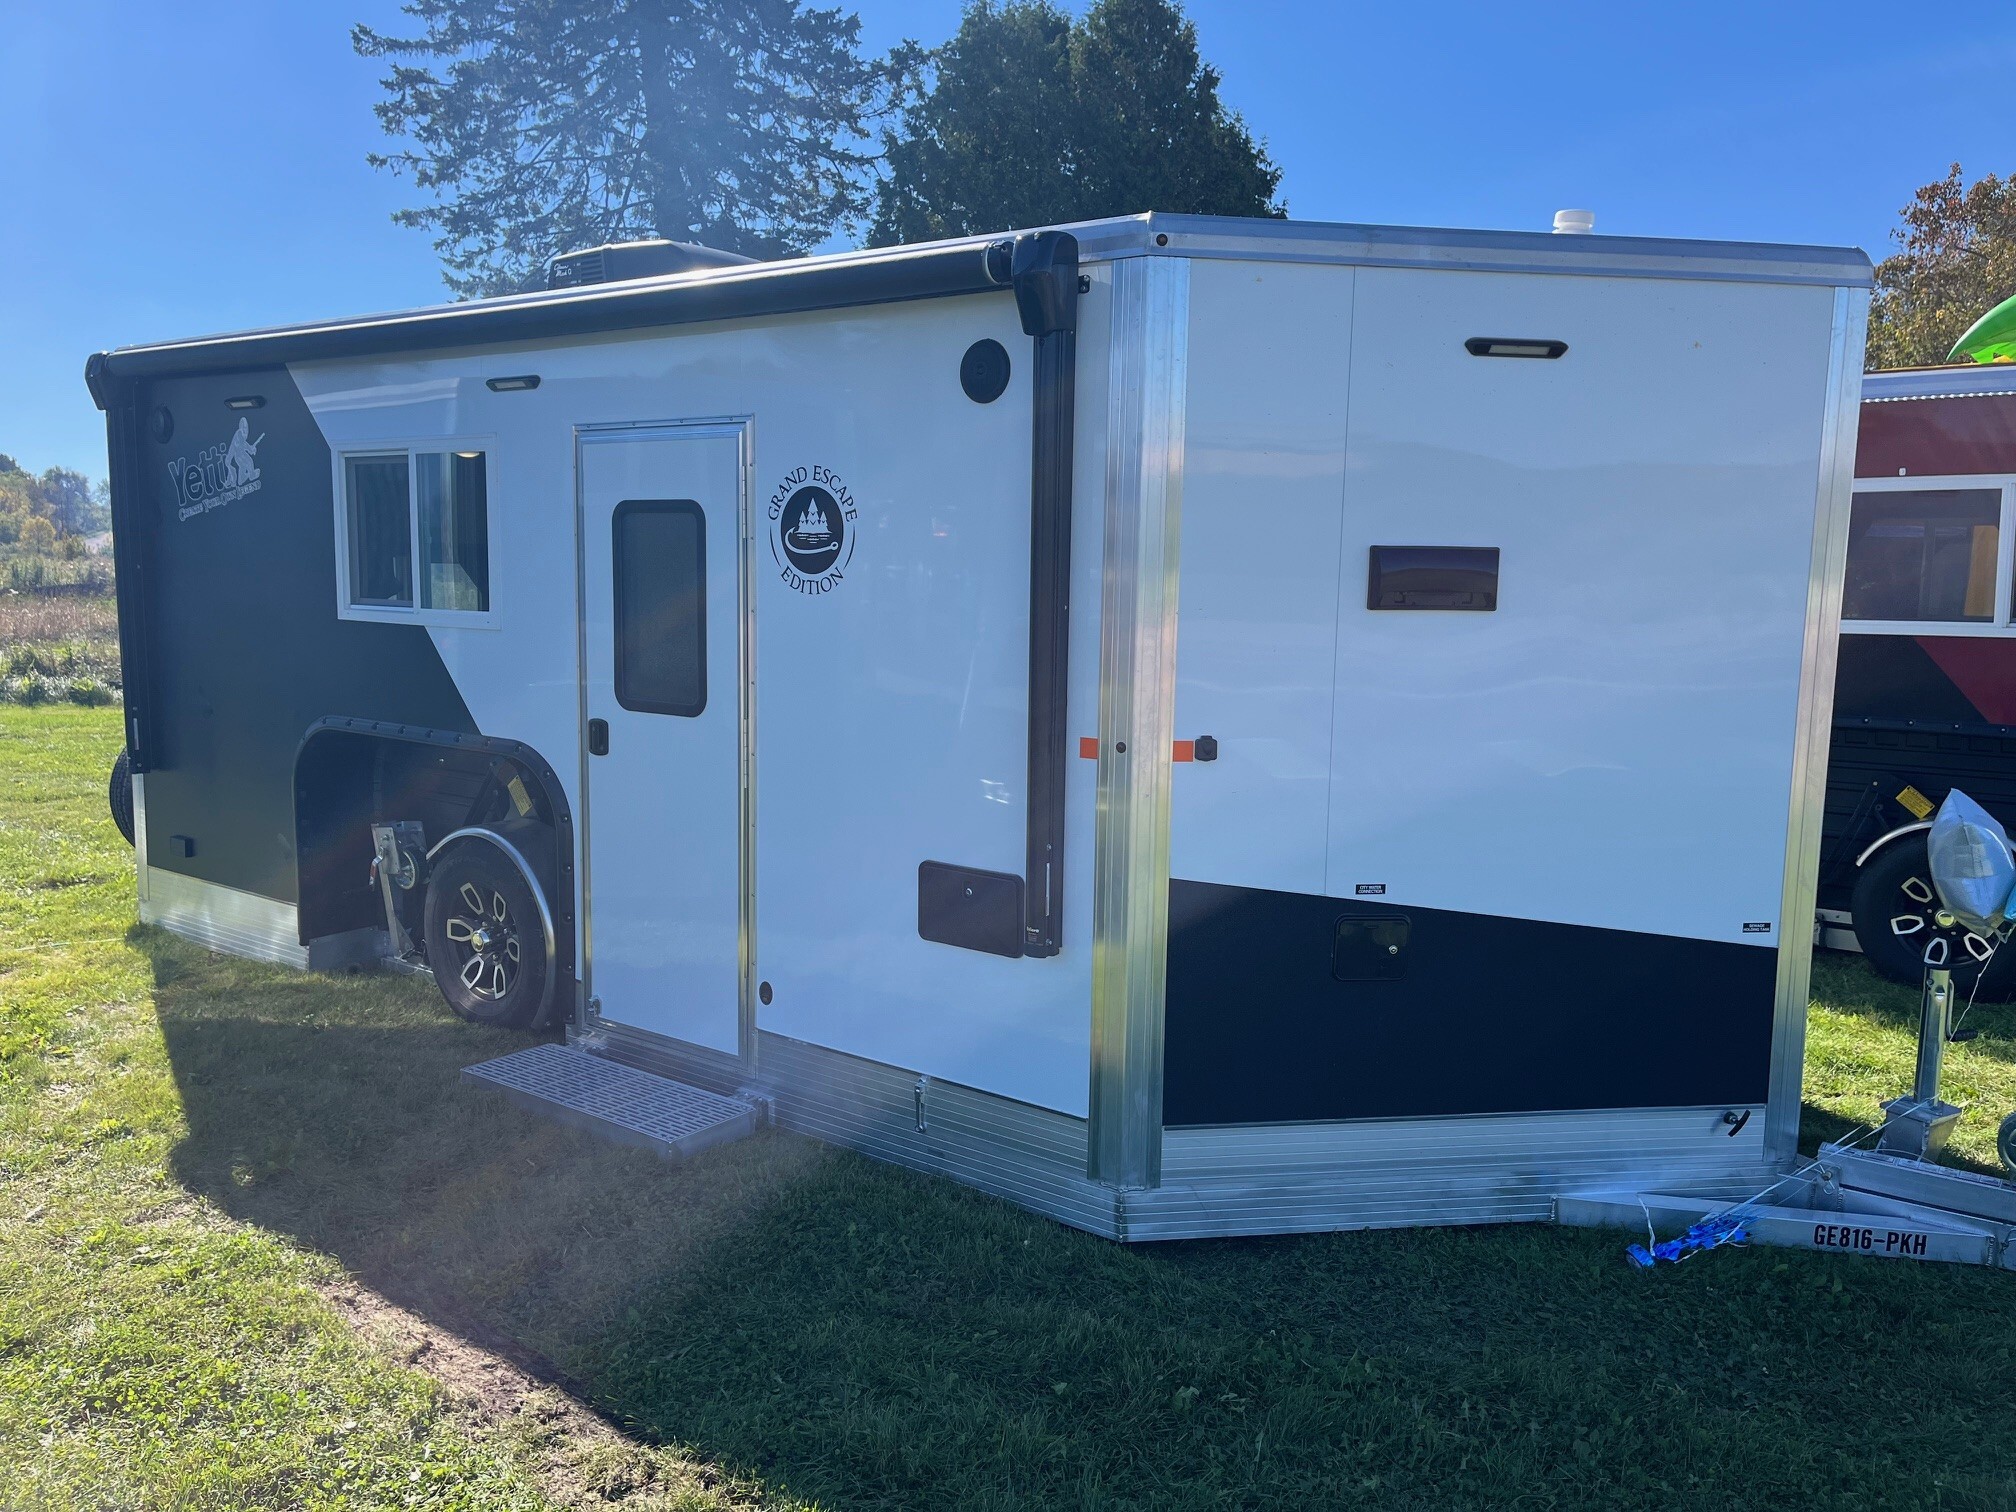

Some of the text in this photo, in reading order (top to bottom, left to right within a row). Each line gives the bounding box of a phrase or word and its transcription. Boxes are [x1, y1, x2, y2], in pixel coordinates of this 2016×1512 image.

[168, 443, 228, 506] Yetti
[768, 465, 858, 522] GRAND ESCAPE
[781, 565, 843, 594] EDITION
[1814, 1225, 1927, 1255] GE816-PKH
